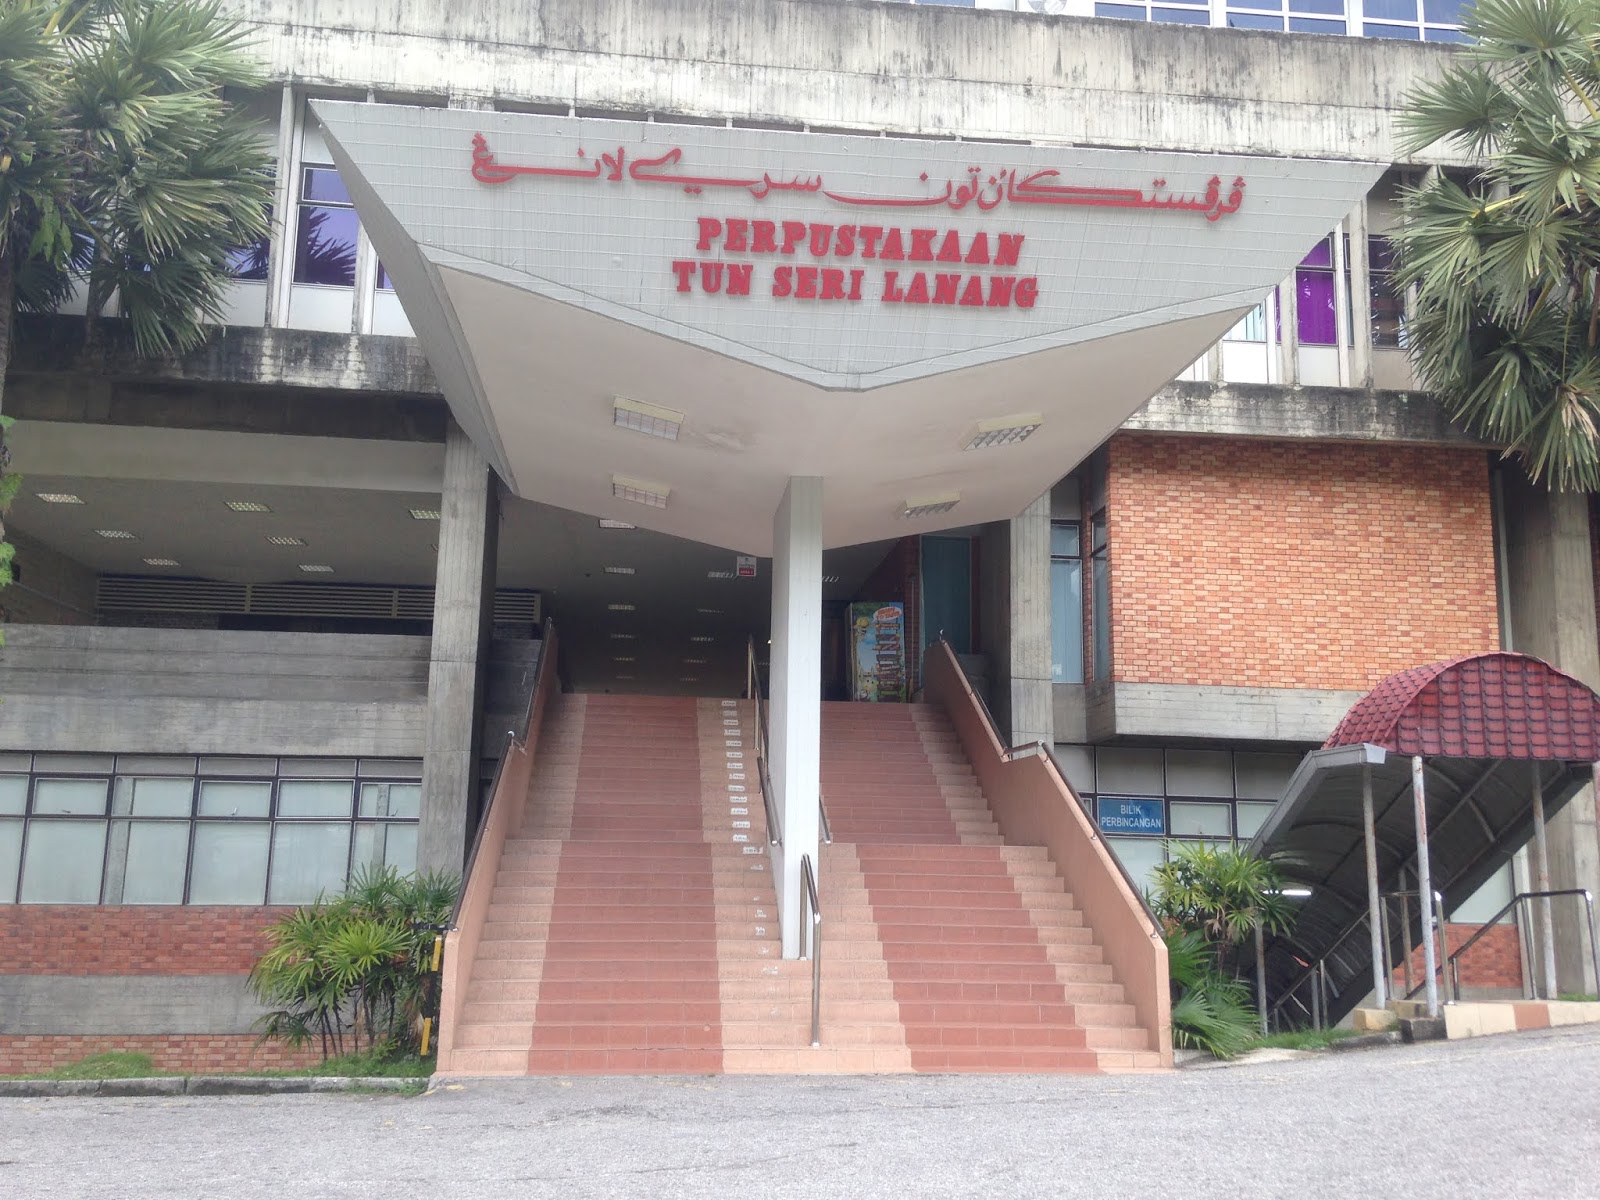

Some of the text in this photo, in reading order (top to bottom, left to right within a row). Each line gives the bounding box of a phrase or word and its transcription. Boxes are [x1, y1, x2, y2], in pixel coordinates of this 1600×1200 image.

[696, 217, 1025, 267] PERPUSTAKAAN
[672, 260, 1039, 309] TUN SERI LANANG
[1101, 816, 1161, 828] PERBINCANGAN
[1120, 804, 1141, 815] BILIK
